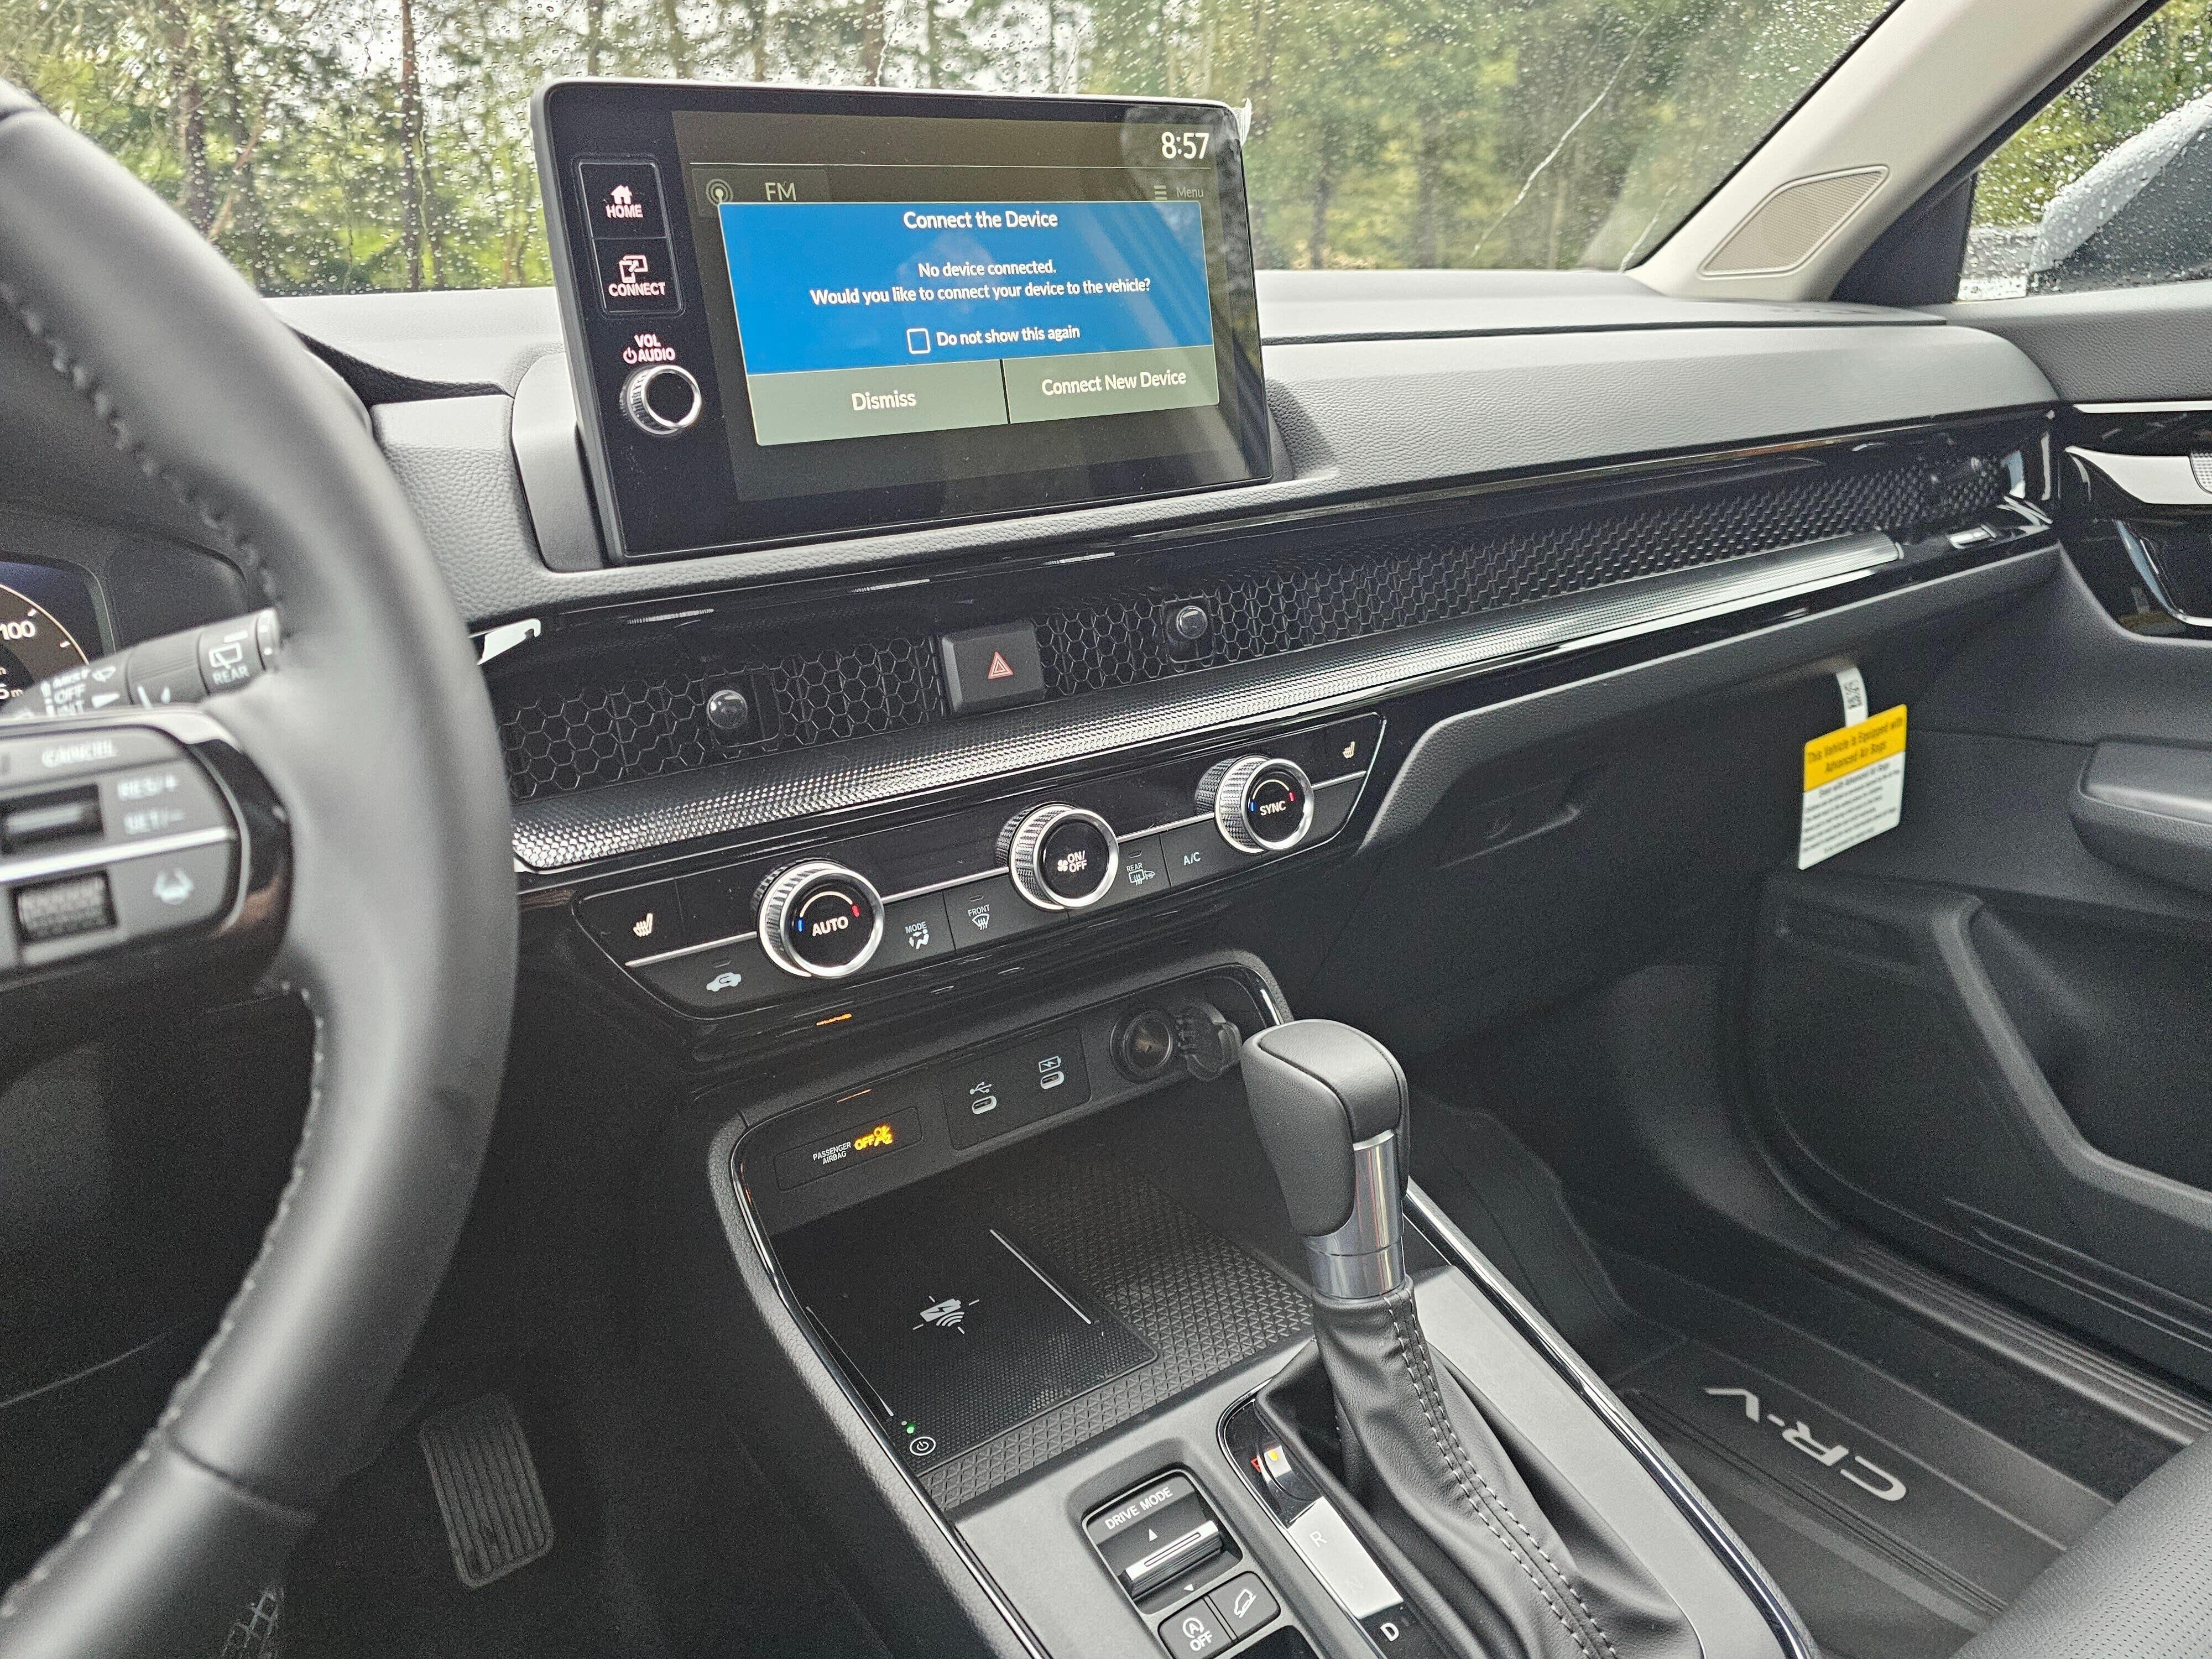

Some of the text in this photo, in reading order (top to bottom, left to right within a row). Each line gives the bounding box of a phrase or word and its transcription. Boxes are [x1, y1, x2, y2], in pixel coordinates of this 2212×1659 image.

[1161, 132, 1209, 159] 8:57
[765, 182, 796, 202] FM
[1177, 186, 1204, 199] Menu
[606, 205, 643, 218] HOME
[904, 210, 1058, 229] Connect the Device
[919, 260, 1056, 277] No device connected.
[609, 281, 665, 296] CONNECT
[810, 278, 1151, 305] Would you like to connect your device to the vehicle?
[634, 334, 661, 348] VOL
[937, 325, 1080, 346] Do not show this again
[638, 347, 675, 362] AUDIO
[1041, 369, 1187, 395] Connect New Device
[852, 390, 916, 411] Dismiss
[212, 665, 249, 685] REAR
[1259, 801, 1286, 816] SYNC
[1067, 850, 1086, 863] ON/
[1183, 852, 1201, 866] A/C
[1068, 859, 1087, 873] OFF
[1126, 862, 1142, 873] REAR
[968, 904, 990, 918] FRONT
[811, 916, 849, 937] AUTO
[905, 921, 927, 935] MODE
[812, 1134, 875, 1161] PASSENGER OFF
[823, 1150, 847, 1165] AIRBAG
[1704, 1388, 1907, 1501] CR-V
[1104, 1486, 1173, 1530] DRIVE MODE
[1308, 1531, 1328, 1548] R
[1190, 1631, 1213, 1651] OFF
[1380, 1623, 1399, 1642] D
